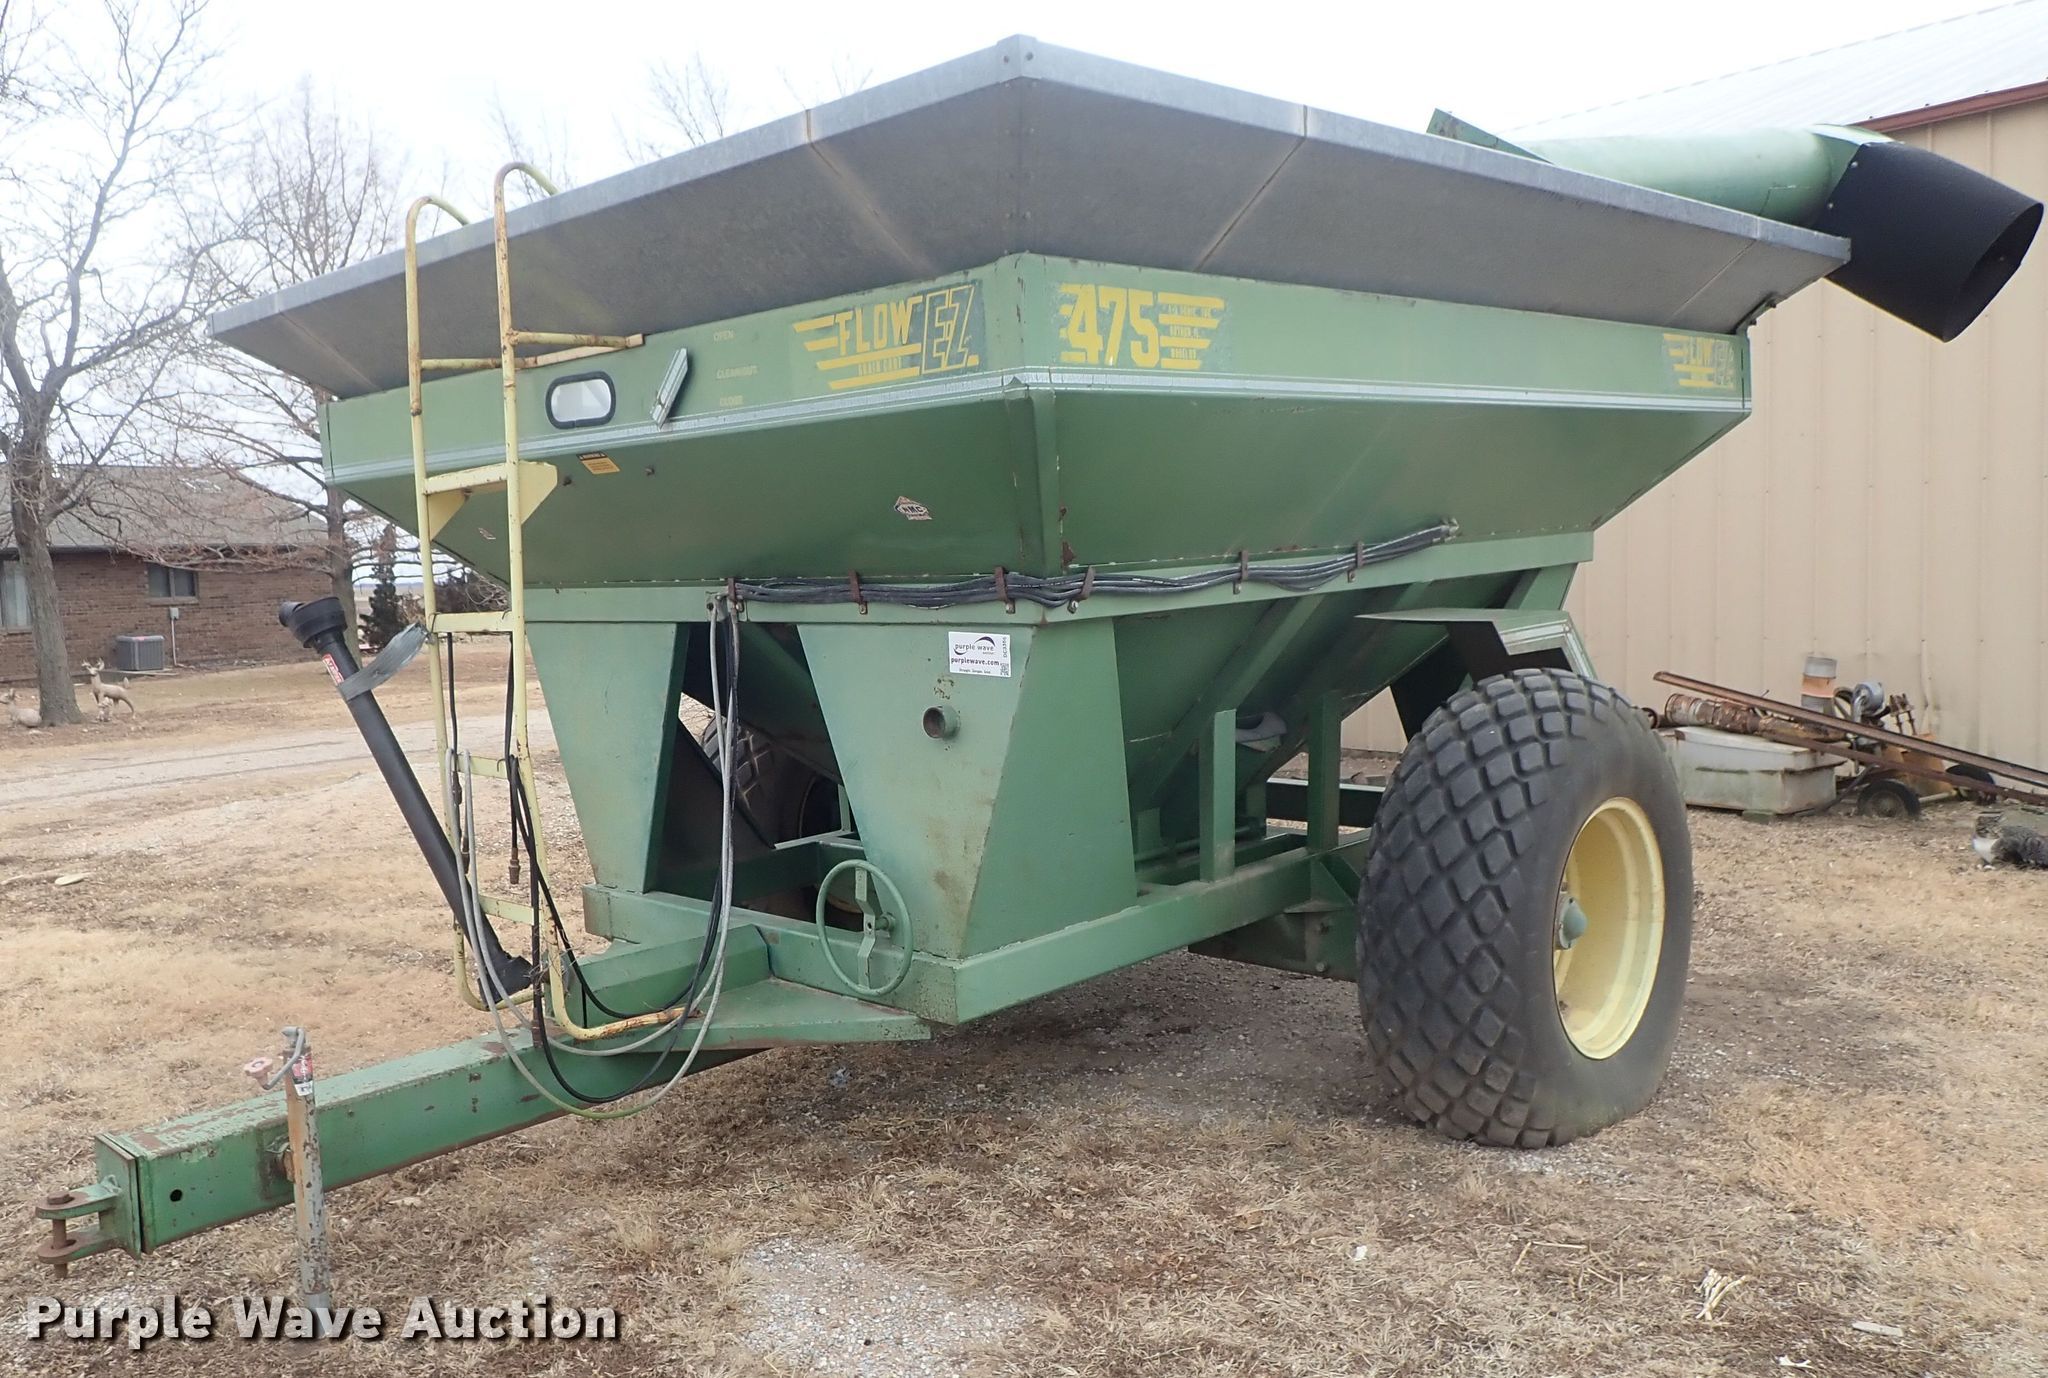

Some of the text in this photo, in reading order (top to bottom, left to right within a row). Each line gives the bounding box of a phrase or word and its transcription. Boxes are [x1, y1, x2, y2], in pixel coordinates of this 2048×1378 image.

[834, 296, 923, 357] FLOW
[1063, 283, 1160, 369] 475
[951, 657, 1000, 666] purplewave.com
[955, 643, 975, 651] purple
